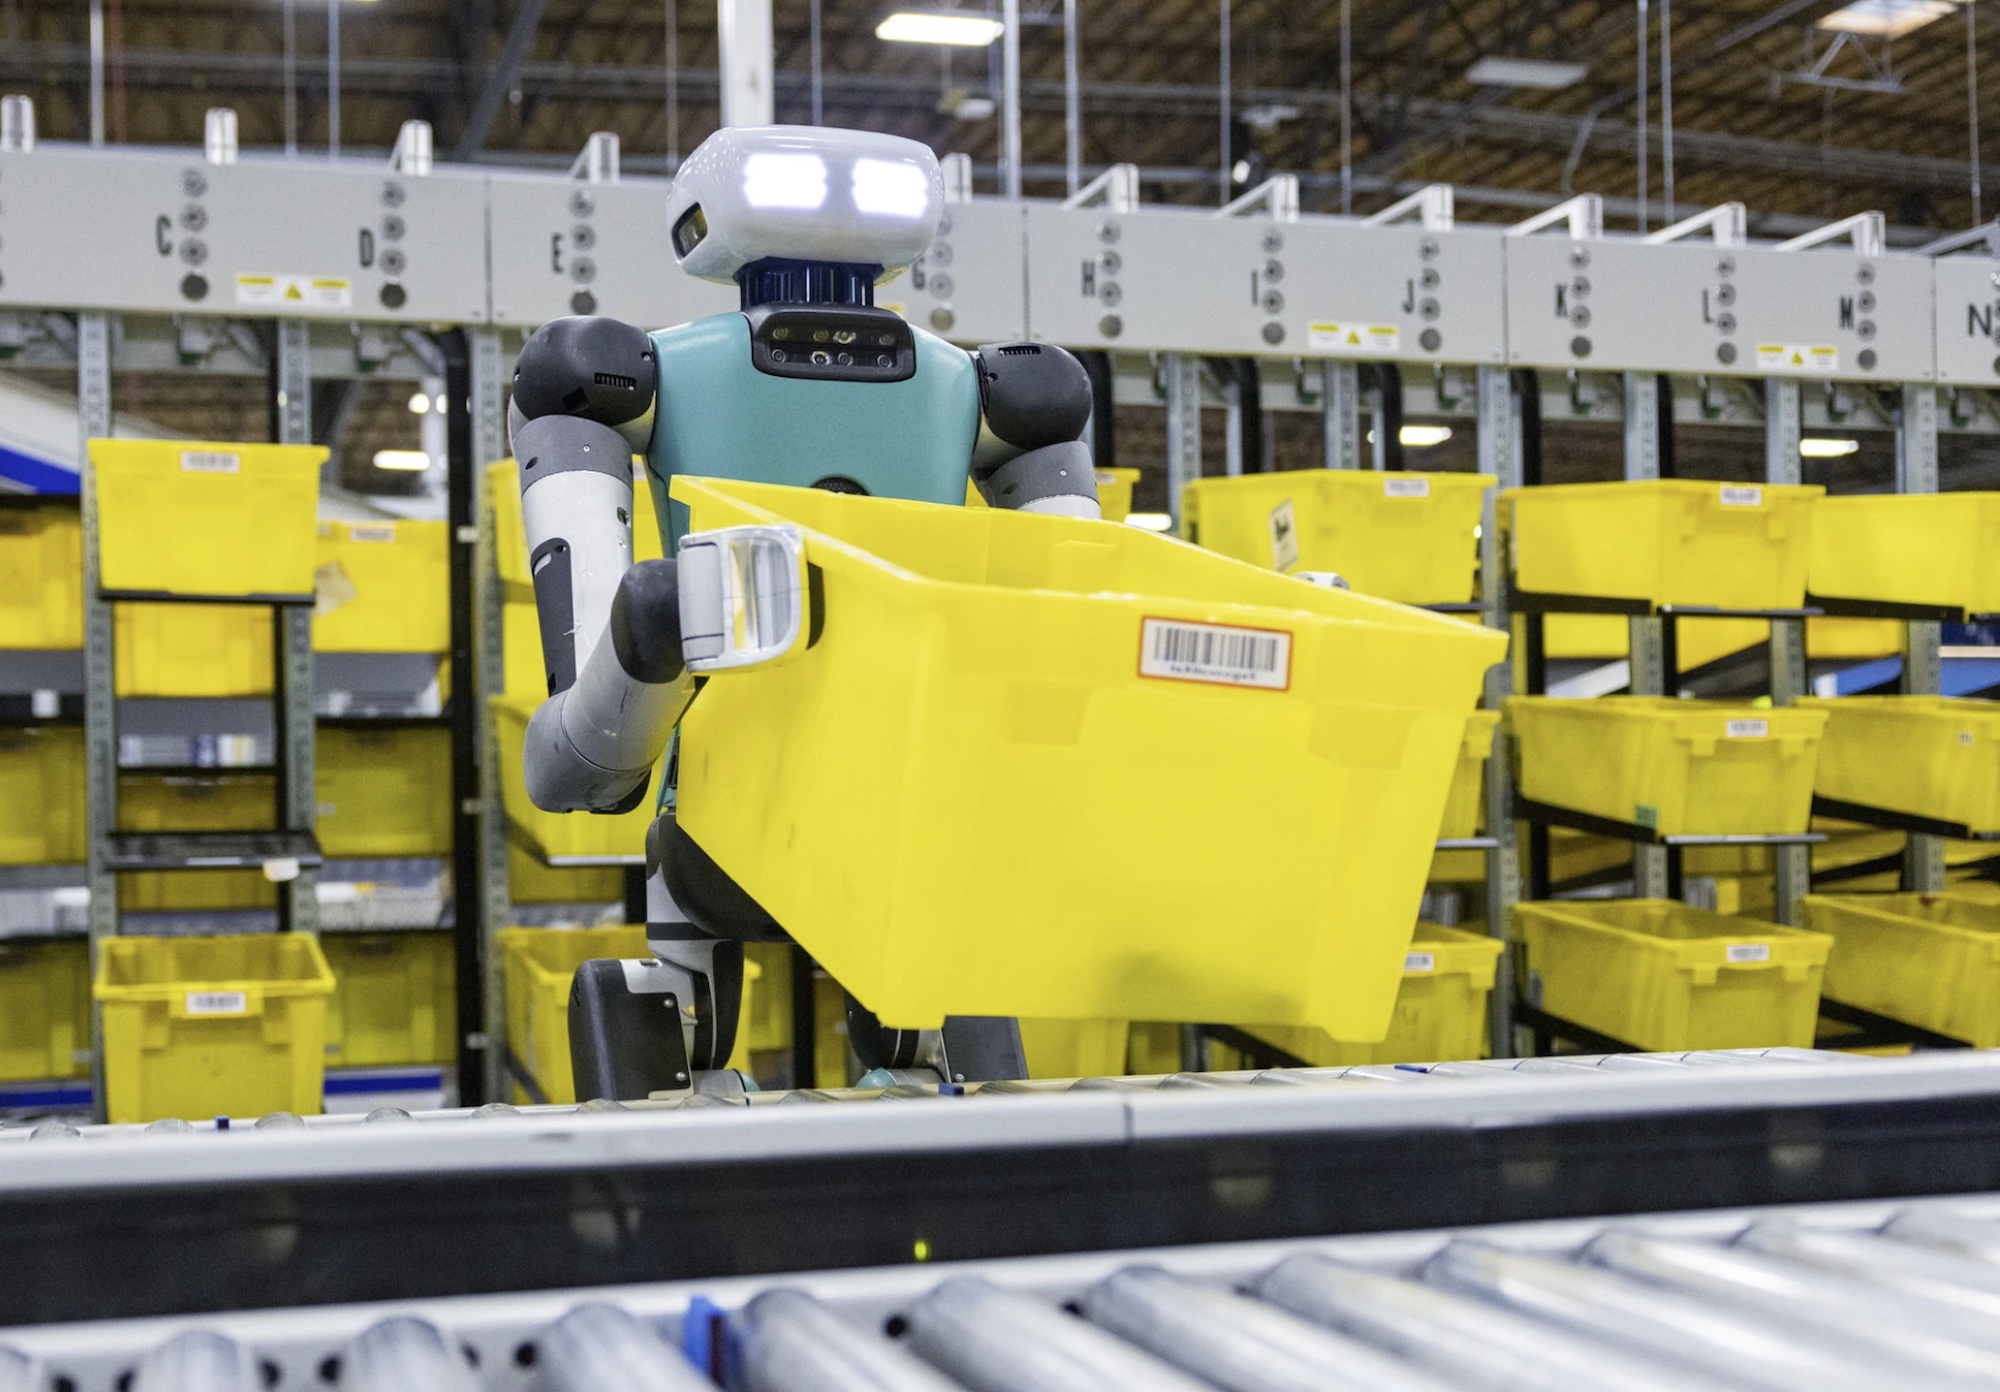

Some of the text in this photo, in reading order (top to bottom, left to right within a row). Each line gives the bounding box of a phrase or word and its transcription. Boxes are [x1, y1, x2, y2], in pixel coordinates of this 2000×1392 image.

[156, 215, 172, 257] C
[359, 228, 375, 270] D
[550, 233, 565, 275] E
[1081, 260, 1095, 298] H
[1403, 278, 1415, 314] J
[1554, 283, 1568, 318] K
[1702, 289, 1714, 324] L
[1840, 297, 1854, 330] M
[1968, 304, 1992, 337] N
